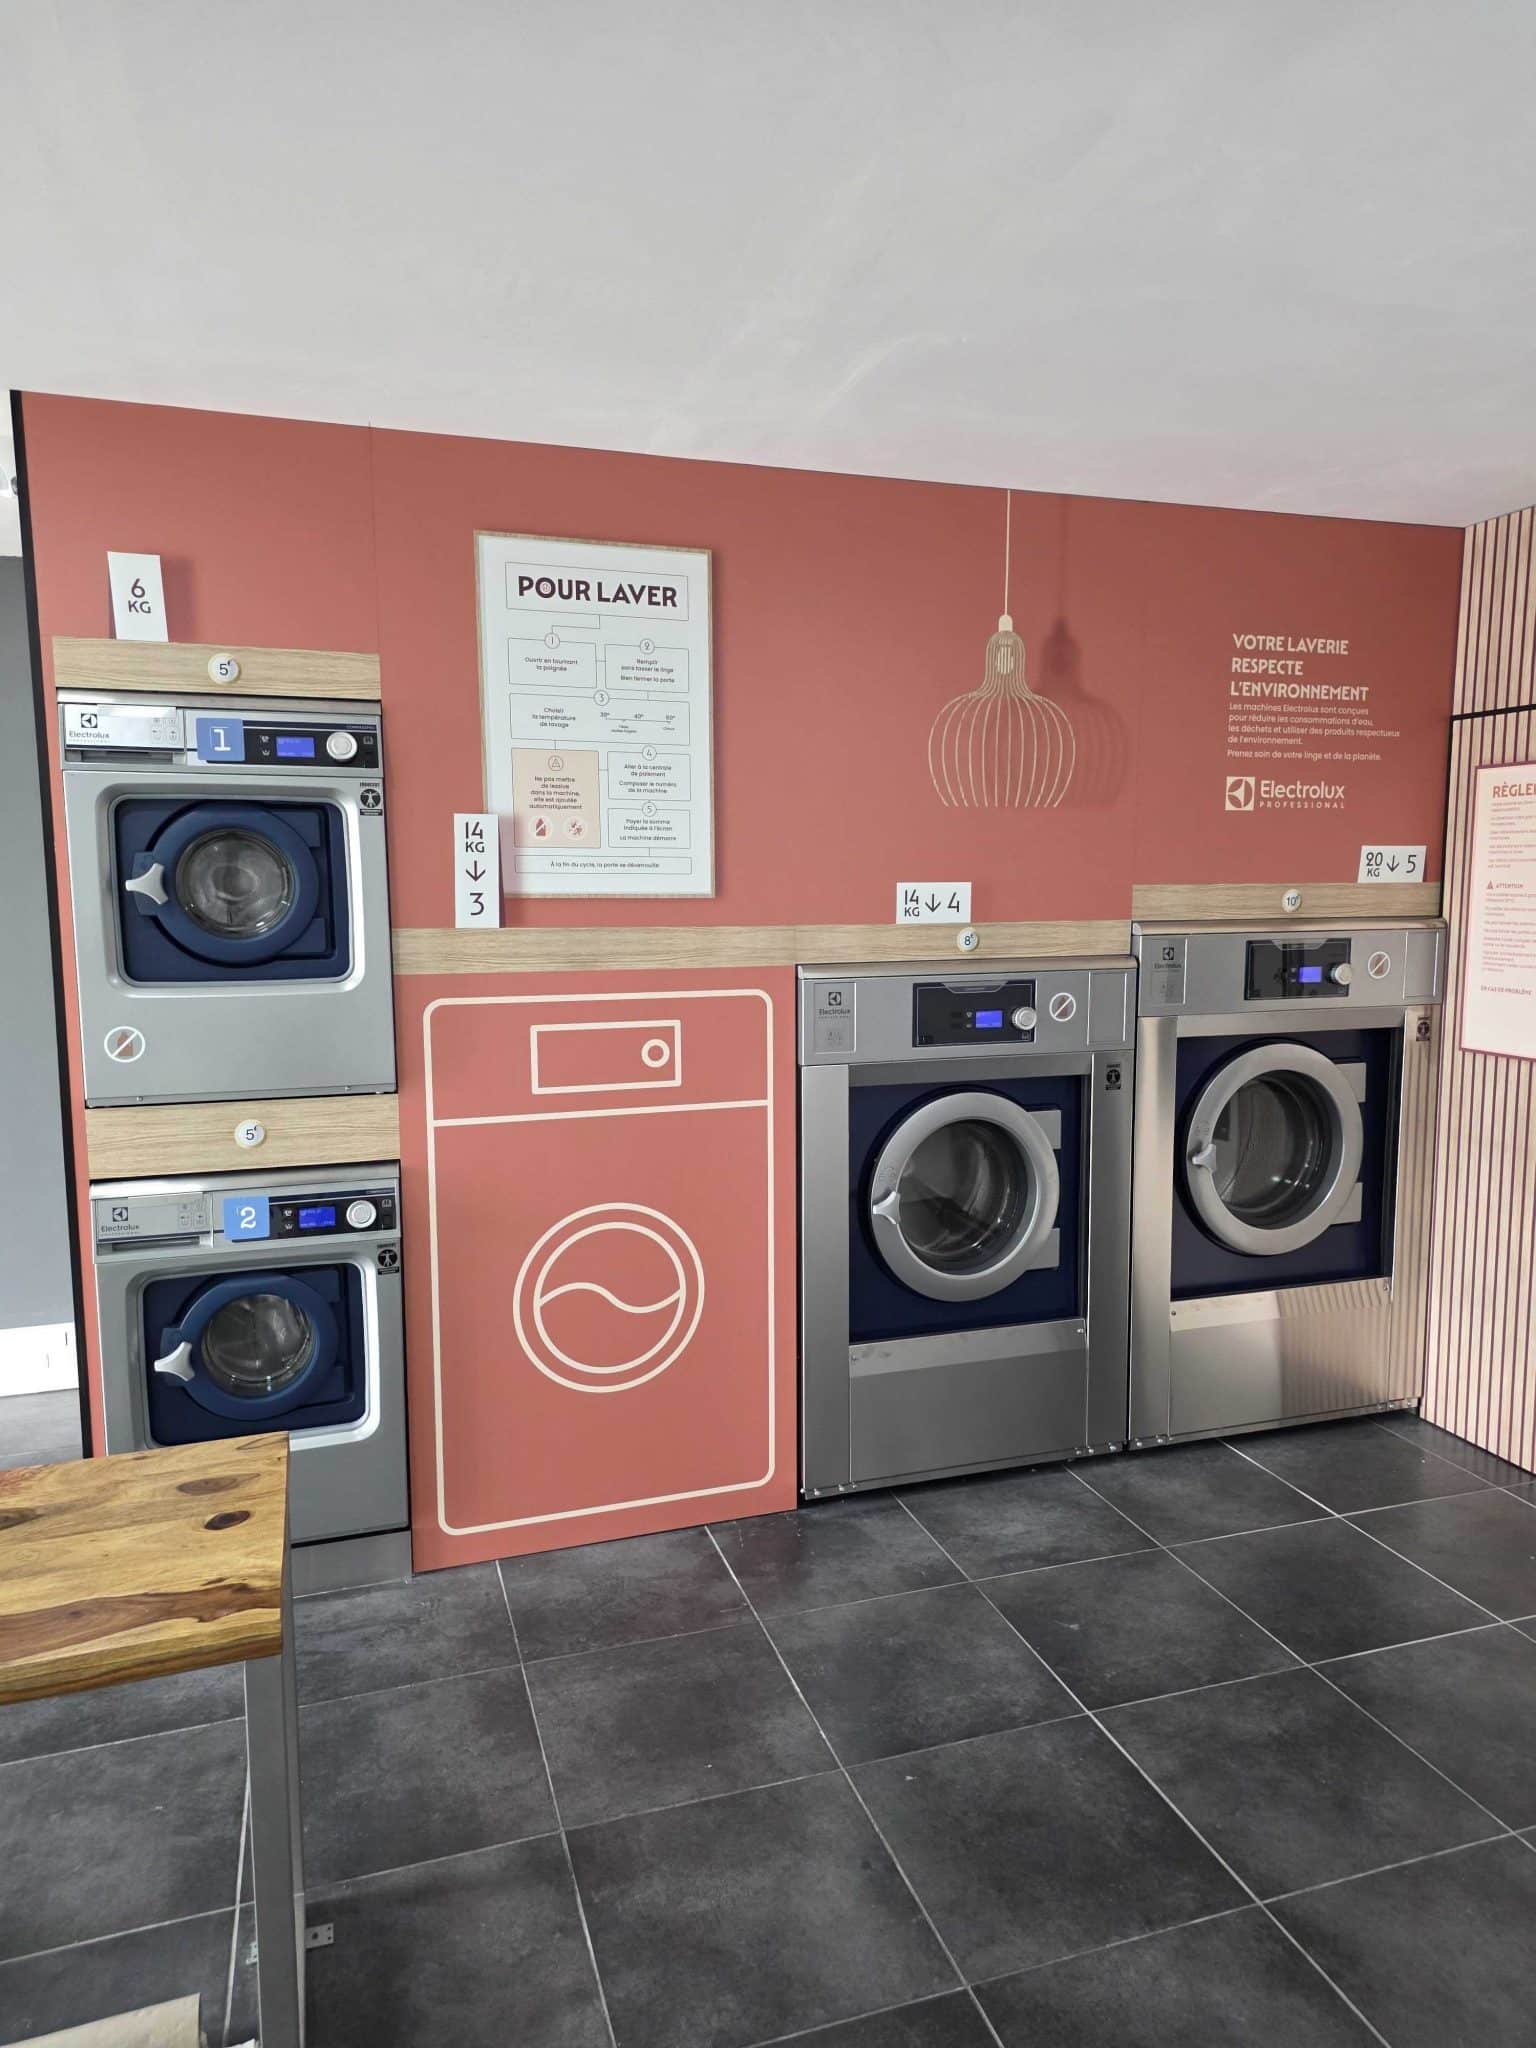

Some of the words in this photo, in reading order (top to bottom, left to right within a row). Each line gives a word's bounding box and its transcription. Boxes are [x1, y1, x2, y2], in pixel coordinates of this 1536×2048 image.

[131, 578, 145, 598] 6
[518, 576, 591, 601] POUR
[597, 581, 677, 607] LAVER
[128, 600, 151, 613] KG
[644, 641, 650, 650] 2
[1232, 633, 1285, 651] VOTRE
[1287, 637, 1349, 655] LAVERIE
[1231, 657, 1304, 676] RESPECTE
[598, 693, 604, 702] 3
[1230, 681, 1369, 701] L'ENVIRONNEMENT
[1229, 703, 1242, 711] Les
[1244, 703, 1281, 712] machines
[1283, 704, 1319, 713] Electrolux
[1320, 706, 1337, 714] sont
[1338, 707, 1369, 716] conçues
[1229, 714, 1247, 723] pour
[1249, 713, 1276, 722] réduire
[1278, 715, 1288, 723] les
[1290, 716, 1350, 725] consommations
[69, 730, 110, 741] Electrolux
[1241, 724, 1272, 733] déchets
[1282, 725, 1307, 734] utiliser
[1309, 727, 1322, 735] des
[1324, 728, 1354, 737] produits
[1356, 729, 1400, 739] respectueux
[213, 728, 231, 751] 1
[1227, 749, 1252, 758] Prenez
[1254, 750, 1270, 758] soin
[1272, 750, 1282, 759] de
[1283, 751, 1303, 759] votre
[1304, 751, 1322, 761] linge
[1324, 752, 1332, 760] et
[1333, 752, 1343, 760] de
[1344, 752, 1351, 760] la
[1260, 780, 1344, 800] Electrolux
[647, 805, 653, 813] 5
[1259, 800, 1344, 809] PROFESSIONAL
[465, 821, 483, 839] 14
[465, 841, 485, 853] KG
[1366, 852, 1383, 867] 20
[1406, 855, 1417, 873] 5
[1367, 867, 1380, 877] KG
[470, 892, 485, 916] 3
[905, 889, 919, 905] 14
[947, 892, 960, 913] 4
[904, 906, 920, 917] KG
[240, 1206, 256, 1229] 2
[101, 1223, 140, 1233] Electrolux
